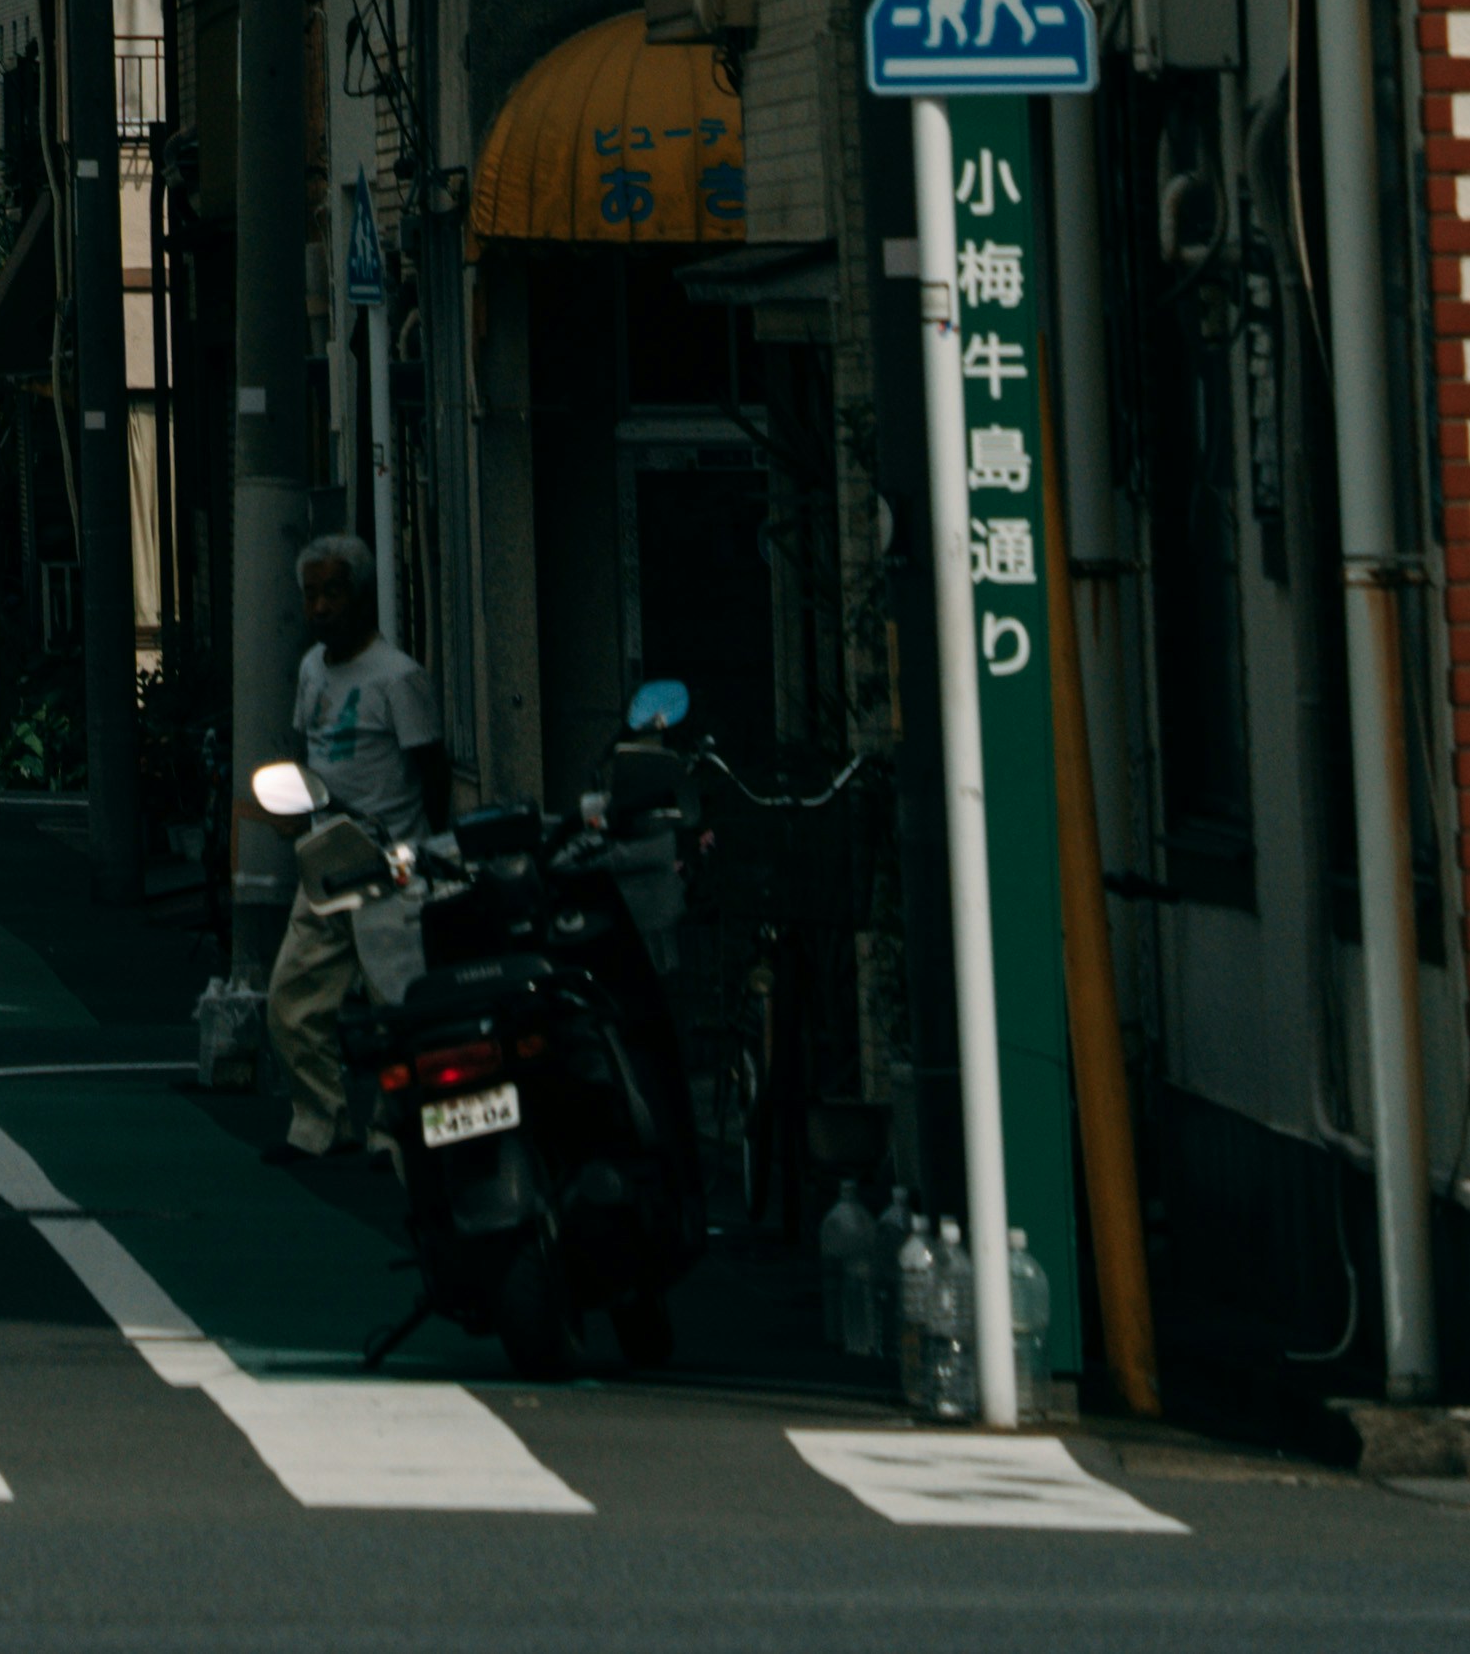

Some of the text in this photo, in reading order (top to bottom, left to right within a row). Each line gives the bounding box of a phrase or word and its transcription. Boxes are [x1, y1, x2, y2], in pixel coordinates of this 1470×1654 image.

[595, 119, 745, 155] ビューテ
[956, 146, 1037, 677] 小梅牛島通り
